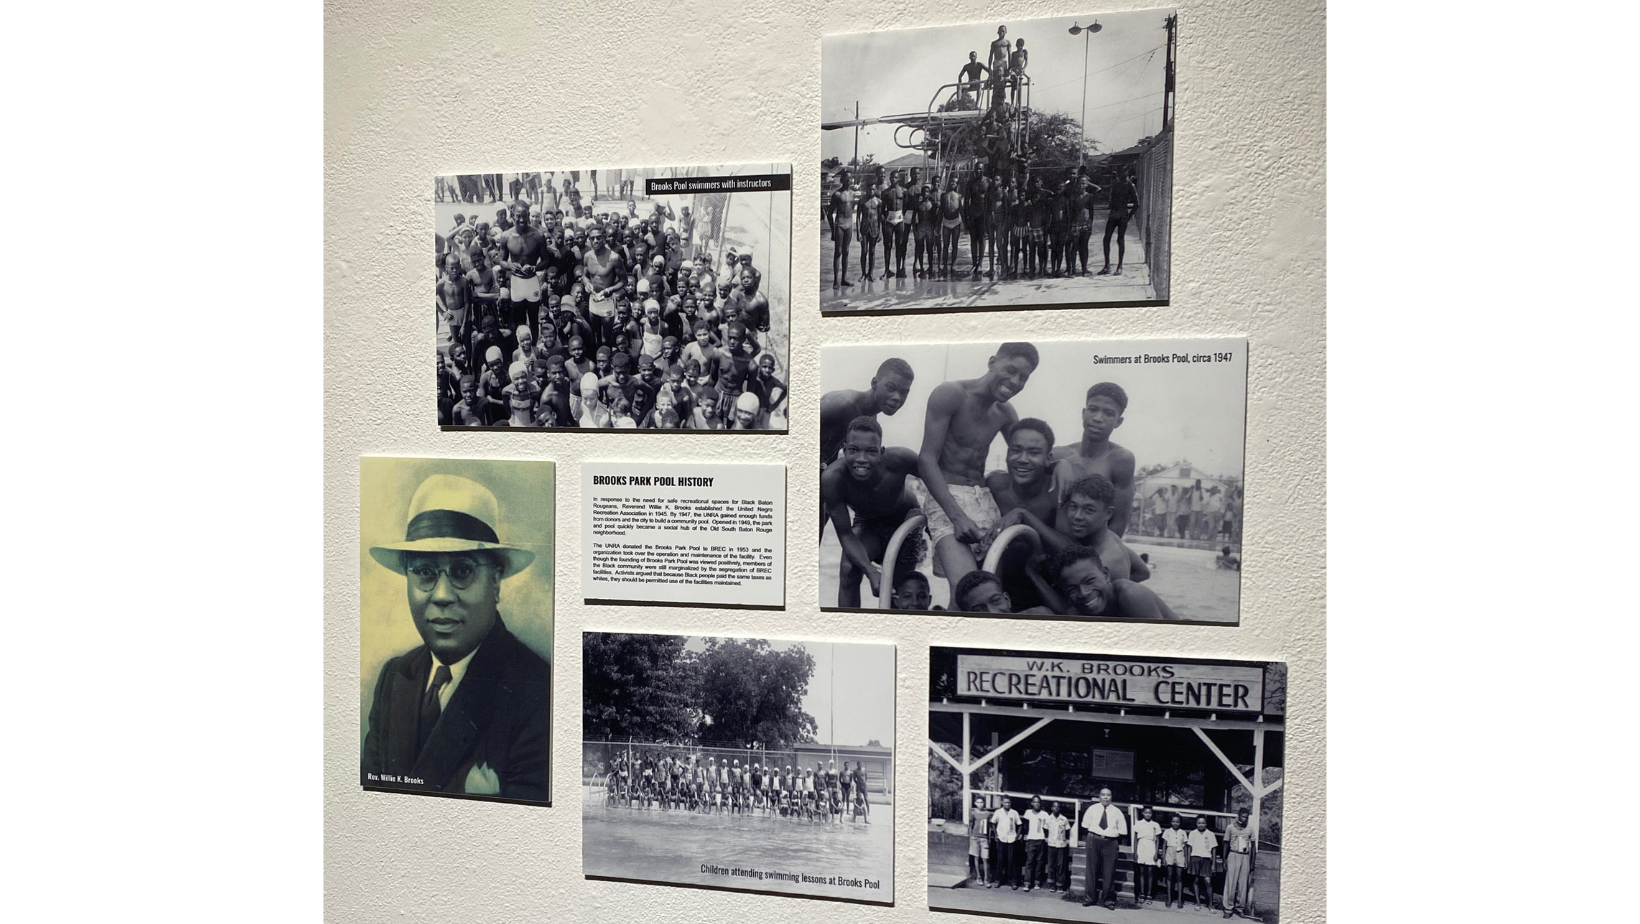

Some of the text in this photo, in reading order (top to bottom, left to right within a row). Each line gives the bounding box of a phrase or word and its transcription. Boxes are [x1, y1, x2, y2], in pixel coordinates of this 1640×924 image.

[651, 179, 772, 191] Brooks Pool swimmers with instructors
[1093, 353, 1232, 364] Swimmers at Brooks Pool, circa 1947
[593, 476, 714, 487] BROOKS PARK POOL HISTORY
[619, 556, 639, 564] founding
[1026, 660, 1175, 678] W.K. BROOKS
[966, 671, 1249, 708] RECREATIONAL CENTER
[381, 774, 396, 782] Willie
[404, 776, 424, 784] Brooks
[700, 864, 880, 889] Children attending swimming lessons at Brooks Pool
